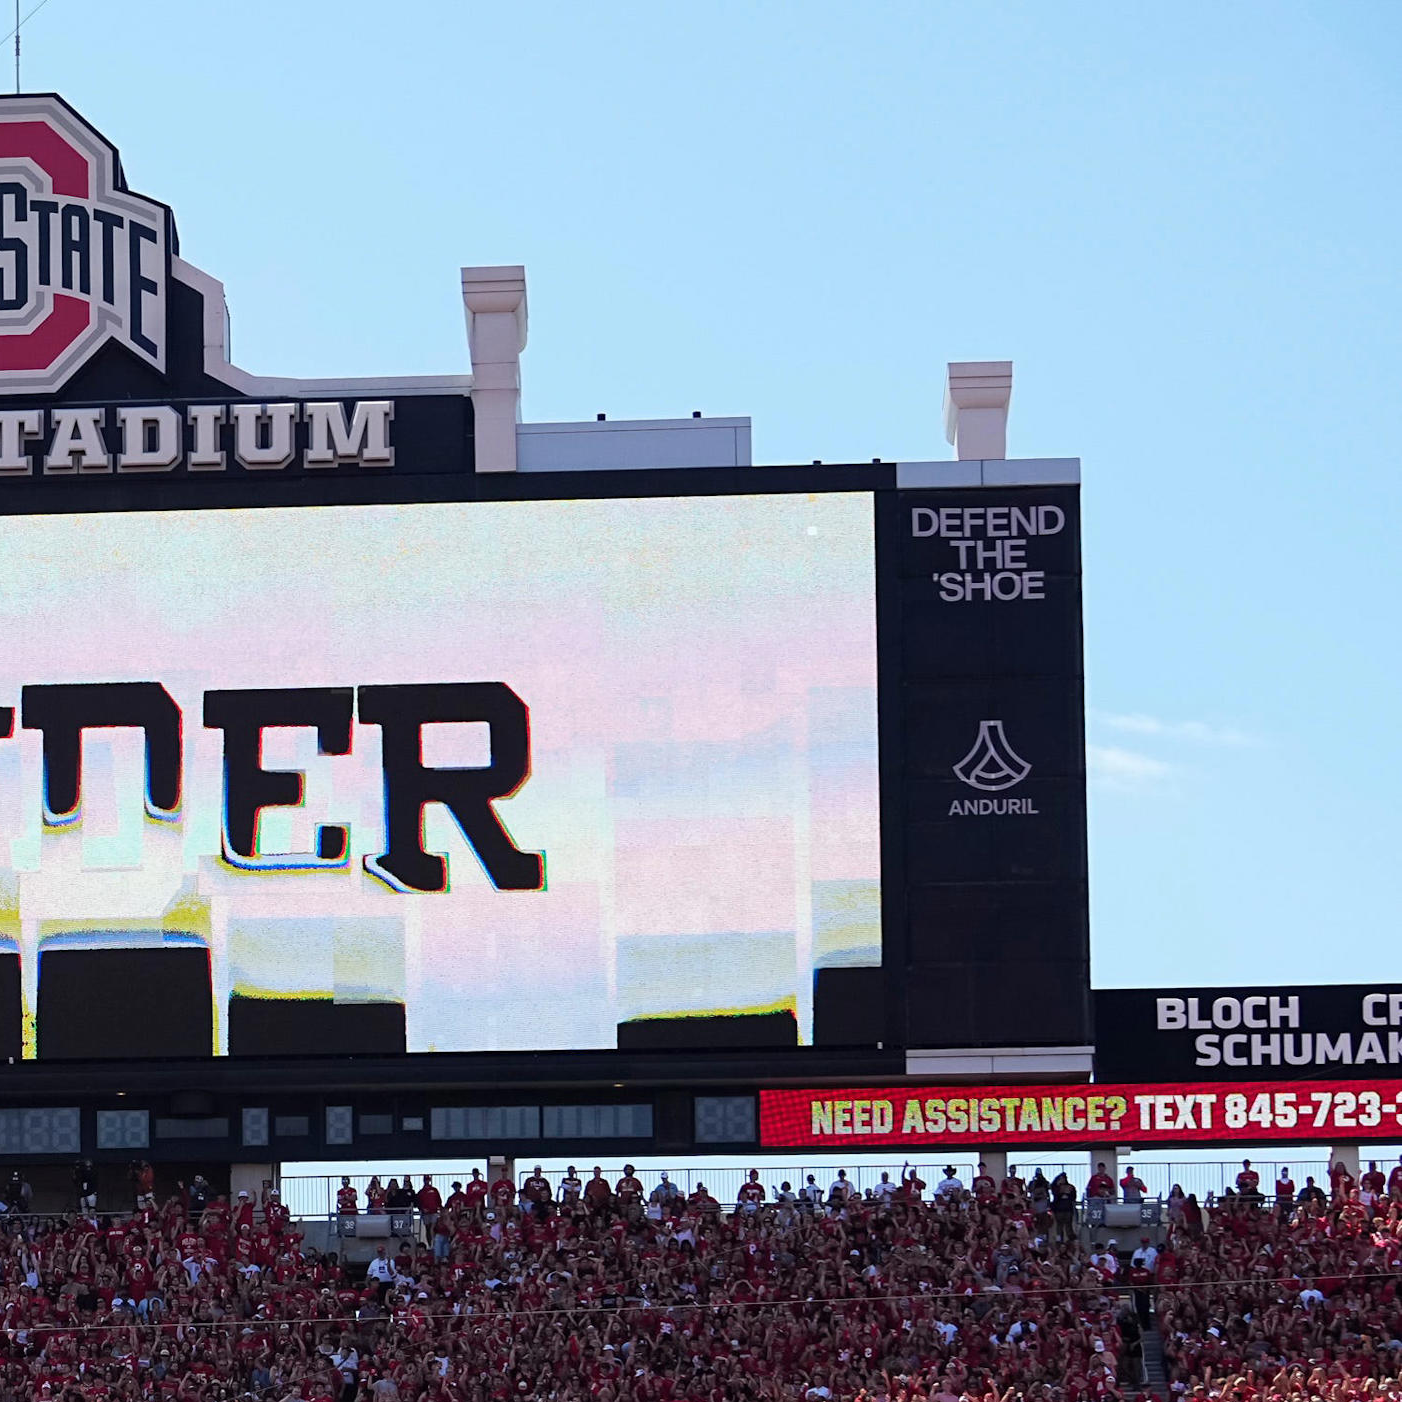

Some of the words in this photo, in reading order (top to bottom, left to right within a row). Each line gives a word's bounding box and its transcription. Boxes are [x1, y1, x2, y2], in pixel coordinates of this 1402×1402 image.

[911, 505, 1065, 537] DEFEND
[950, 539, 1028, 569] THE
[933, 571, 1045, 601] 'SHOE
[948, 798, 1040, 816] ANDURIL
[1156, 995, 1300, 1030] BLOCH
[811, 1099, 894, 1135] NEED
[902, 1094, 1128, 1134] ASSISTANCE?
[1134, 1093, 1217, 1130] TEXT
